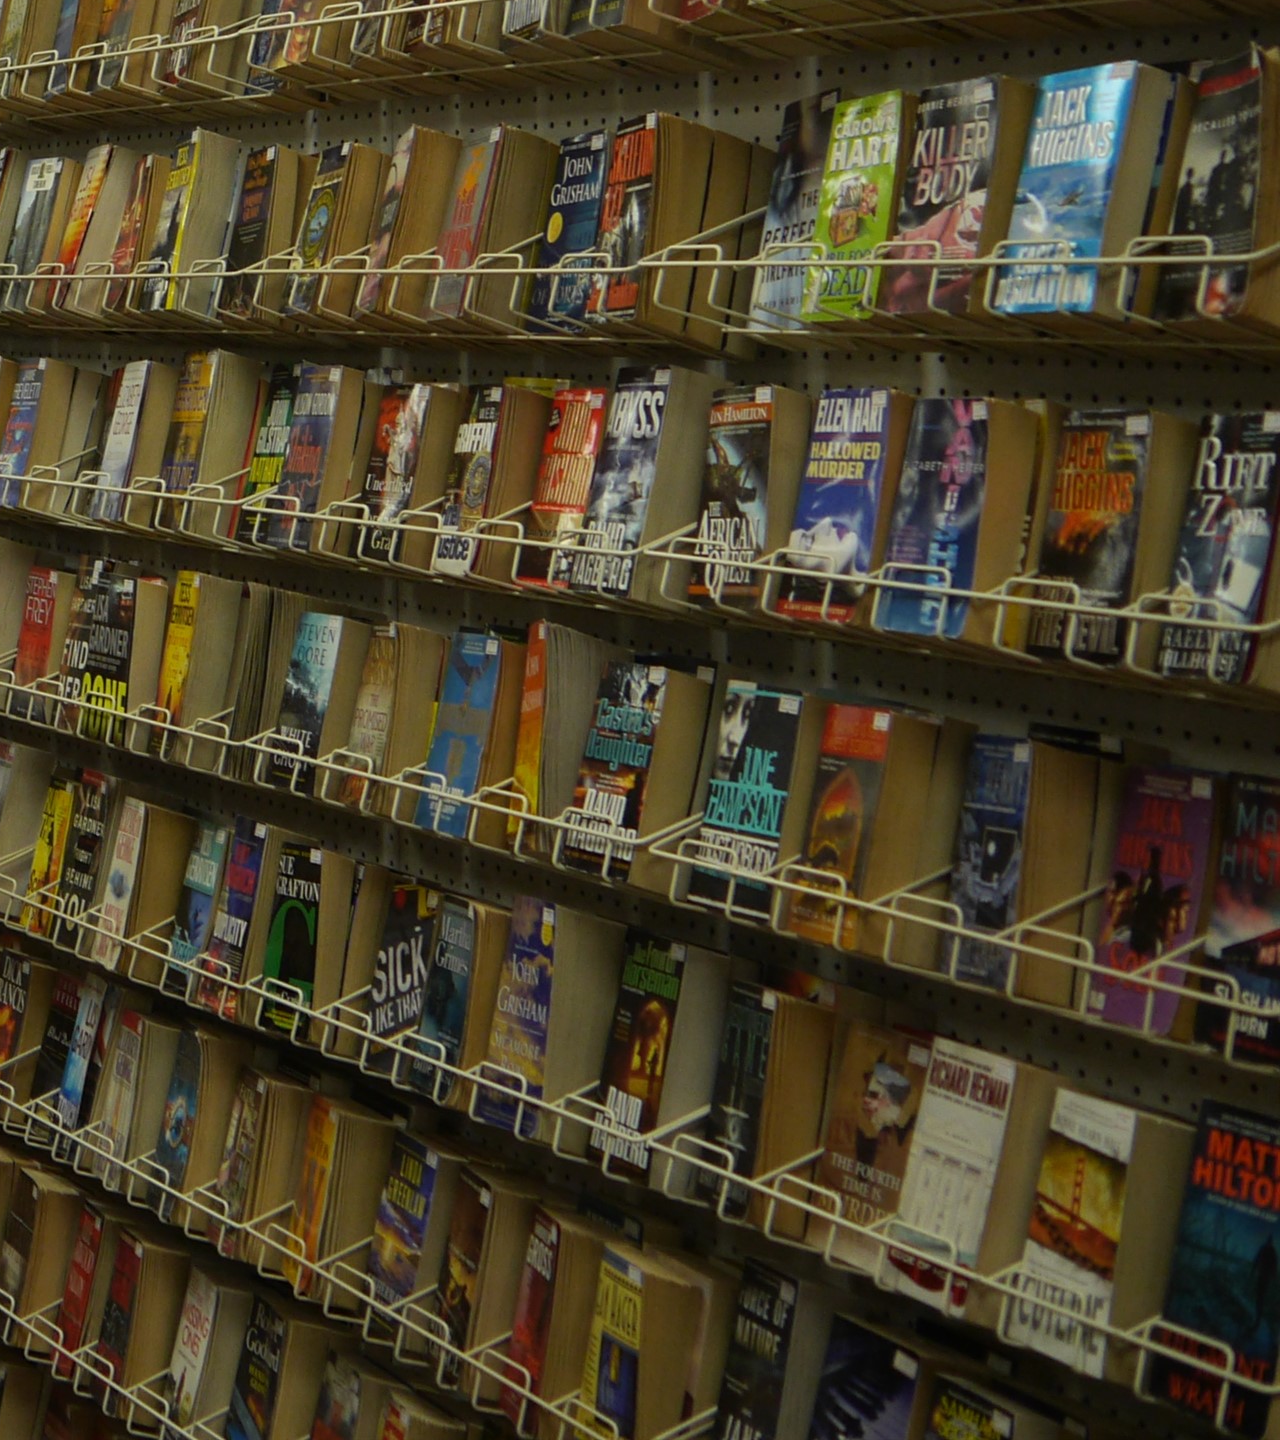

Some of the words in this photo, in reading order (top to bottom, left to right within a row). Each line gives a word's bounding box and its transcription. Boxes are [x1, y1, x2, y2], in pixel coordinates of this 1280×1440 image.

[1037, 85, 1092, 129] JACK
[830, 132, 896, 172] HART
[913, 120, 990, 167] KILLER
[1030, 120, 1116, 168] HIGGINS
[562, 155, 594, 184] JOHN
[913, 163, 978, 206] BODY
[550, 182, 600, 207] GRISHAM
[801, 190, 819, 208] THE
[608, 390, 665, 439] ABYSS
[724, 406, 769, 422] HAMILTON
[815, 398, 849, 433] ELLEN
[810, 441, 881, 460] HALLOWED
[1057, 431, 1110, 470] JACK
[1193, 435, 1277, 491] RIFT
[806, 460, 865, 480] MURDER
[1052, 471, 1135, 513] HIGGINS
[439, 535, 470, 560] ustice
[694, 509, 759, 555] AFRICAN
[25, 596, 54, 626] FREY
[90, 623, 129, 659] GARDNER
[297, 623, 336, 645] STEVEN
[61, 638, 89, 670] FIND
[596, 697, 655, 736] Castro's
[279, 725, 313, 749] WHITE
[585, 728, 653, 771] Daughter
[739, 746, 778, 789] JUNE
[86, 793, 101, 811] LISA
[584, 788, 628, 827] DAVID
[703, 779, 789, 837] HAMPSON
[73, 813, 104, 837] GARDNER
[64, 866, 93, 891] BEHIND
[278, 854, 295, 875] SUE
[276, 875, 321, 901] GRAFTON
[2, 955, 22, 986] DICK
[371, 934, 429, 1003] SICK
[435, 940, 470, 977] Grimes
[512, 954, 540, 986] JOHN
[369, 1000, 395, 1035] LIKE
[496, 984, 548, 1025] GRISHAM
[930, 1057, 970, 1097] RICHARD
[831, 1153, 855, 1173] THE
[856, 1160, 902, 1191] FOURTH
[842, 1173, 869, 1194] TIME
[871, 1185, 883, 1203] IS
